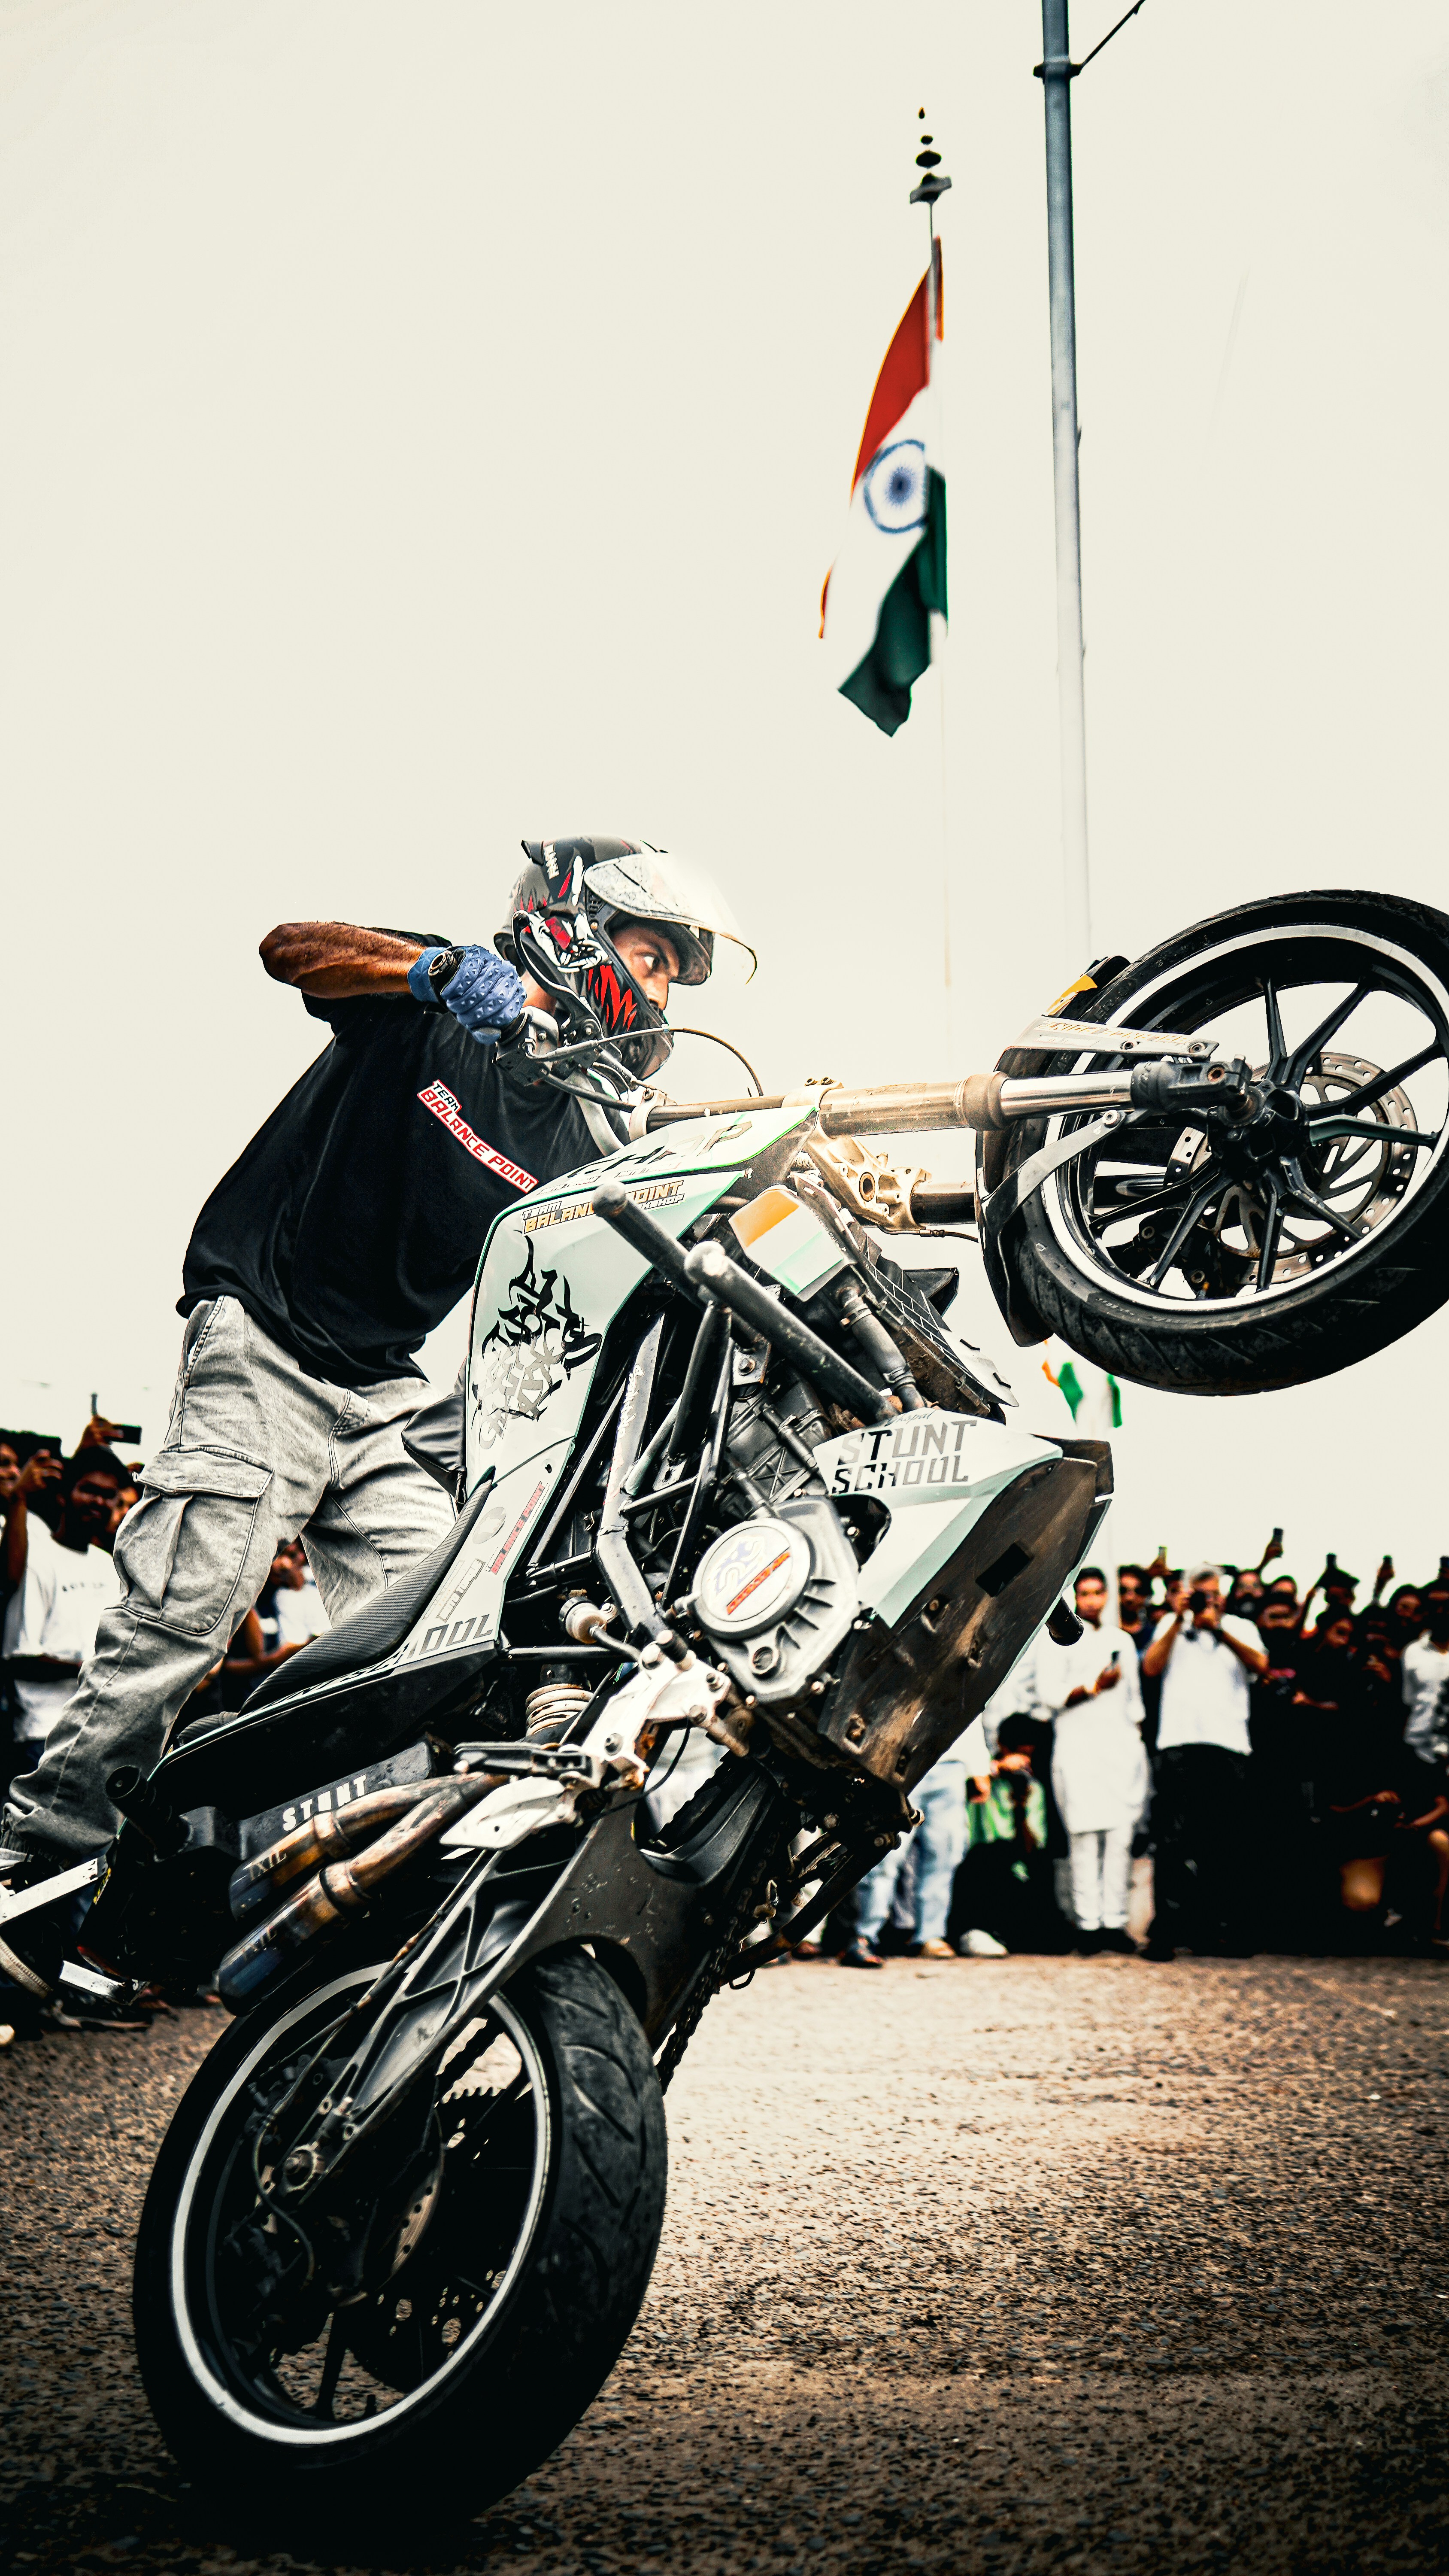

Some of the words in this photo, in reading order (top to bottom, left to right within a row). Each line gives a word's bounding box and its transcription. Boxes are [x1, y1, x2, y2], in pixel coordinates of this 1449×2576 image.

[433, 1083, 458, 1112] TEAM
[421, 1089, 490, 1157] BALANCE
[488, 1155, 535, 1189] POINT
[522, 1200, 562, 1220] TEAM
[838, 1420, 977, 1465] STUNT
[832, 1455, 969, 1494] SCHOOL
[490, 1520, 527, 1575] BALANCE
[522, 1481, 546, 1517] POINT
[283, 1774, 366, 1831] STUNT
